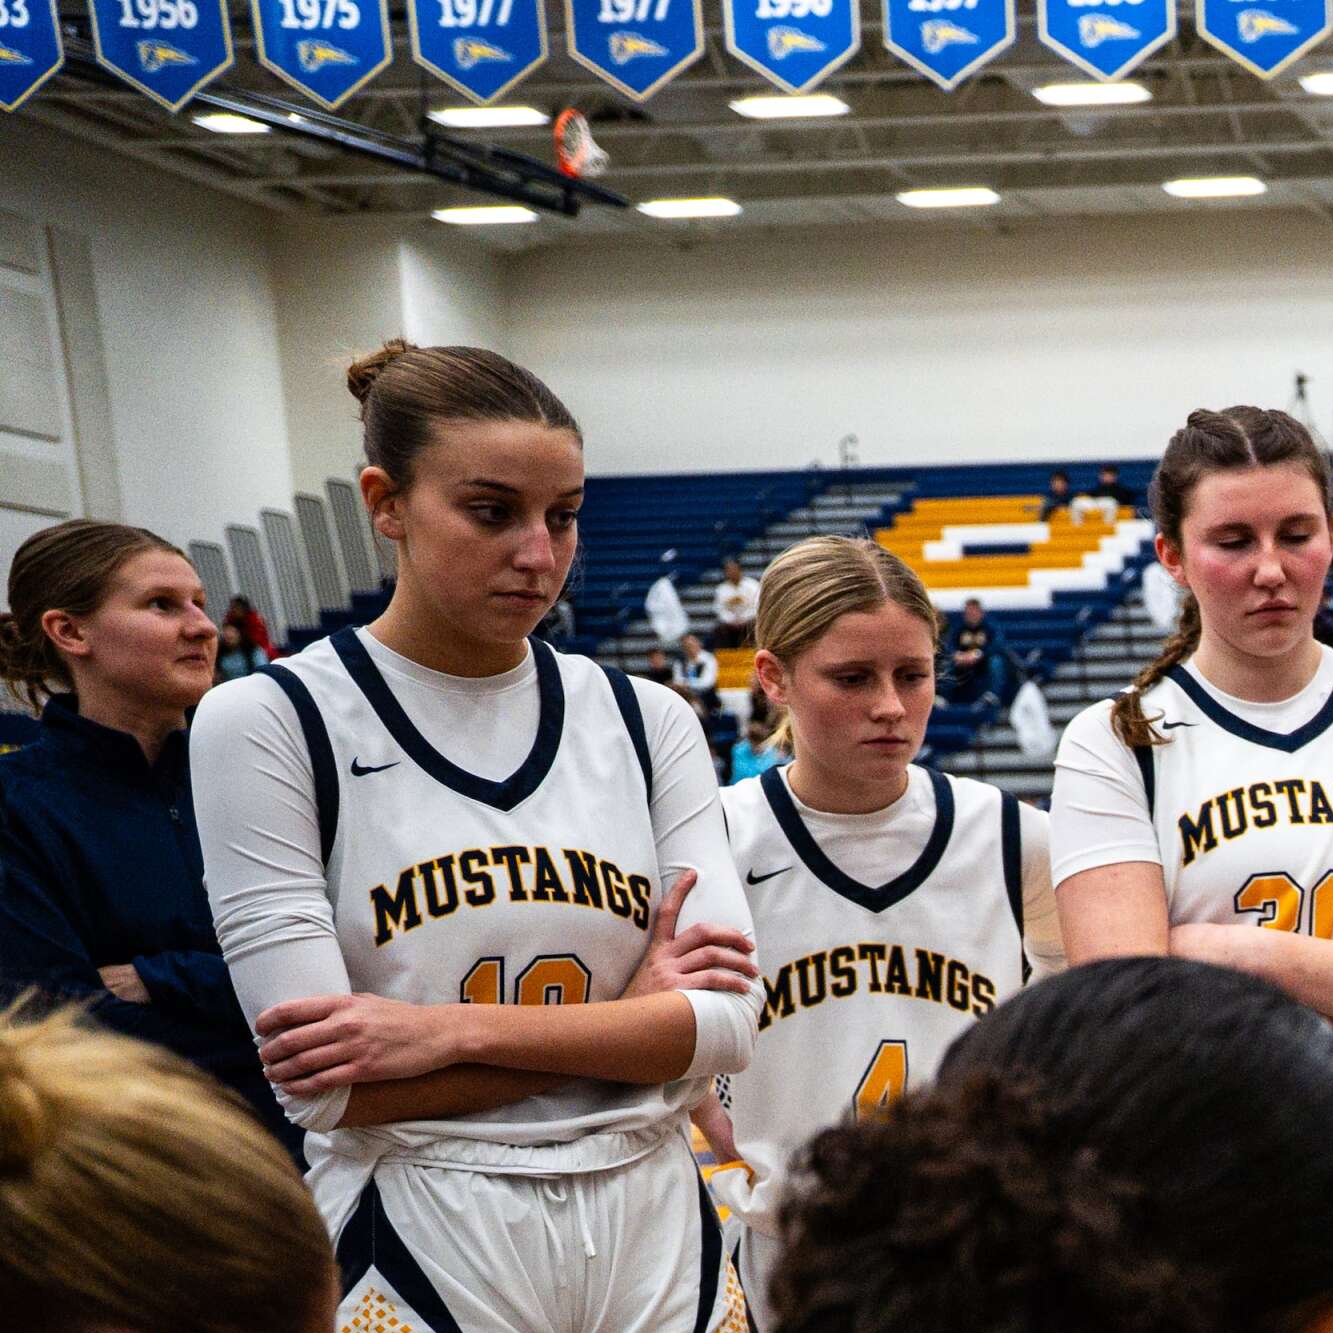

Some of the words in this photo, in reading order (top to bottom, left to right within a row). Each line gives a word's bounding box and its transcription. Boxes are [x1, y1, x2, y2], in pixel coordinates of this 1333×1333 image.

[119, 0, 199, 29] 1956
[280, 0, 361, 30] 1975
[438, 0, 514, 27] 1977
[369, 846, 651, 948] MUSTANGS
[758, 942, 998, 1033] MUSTANGS
